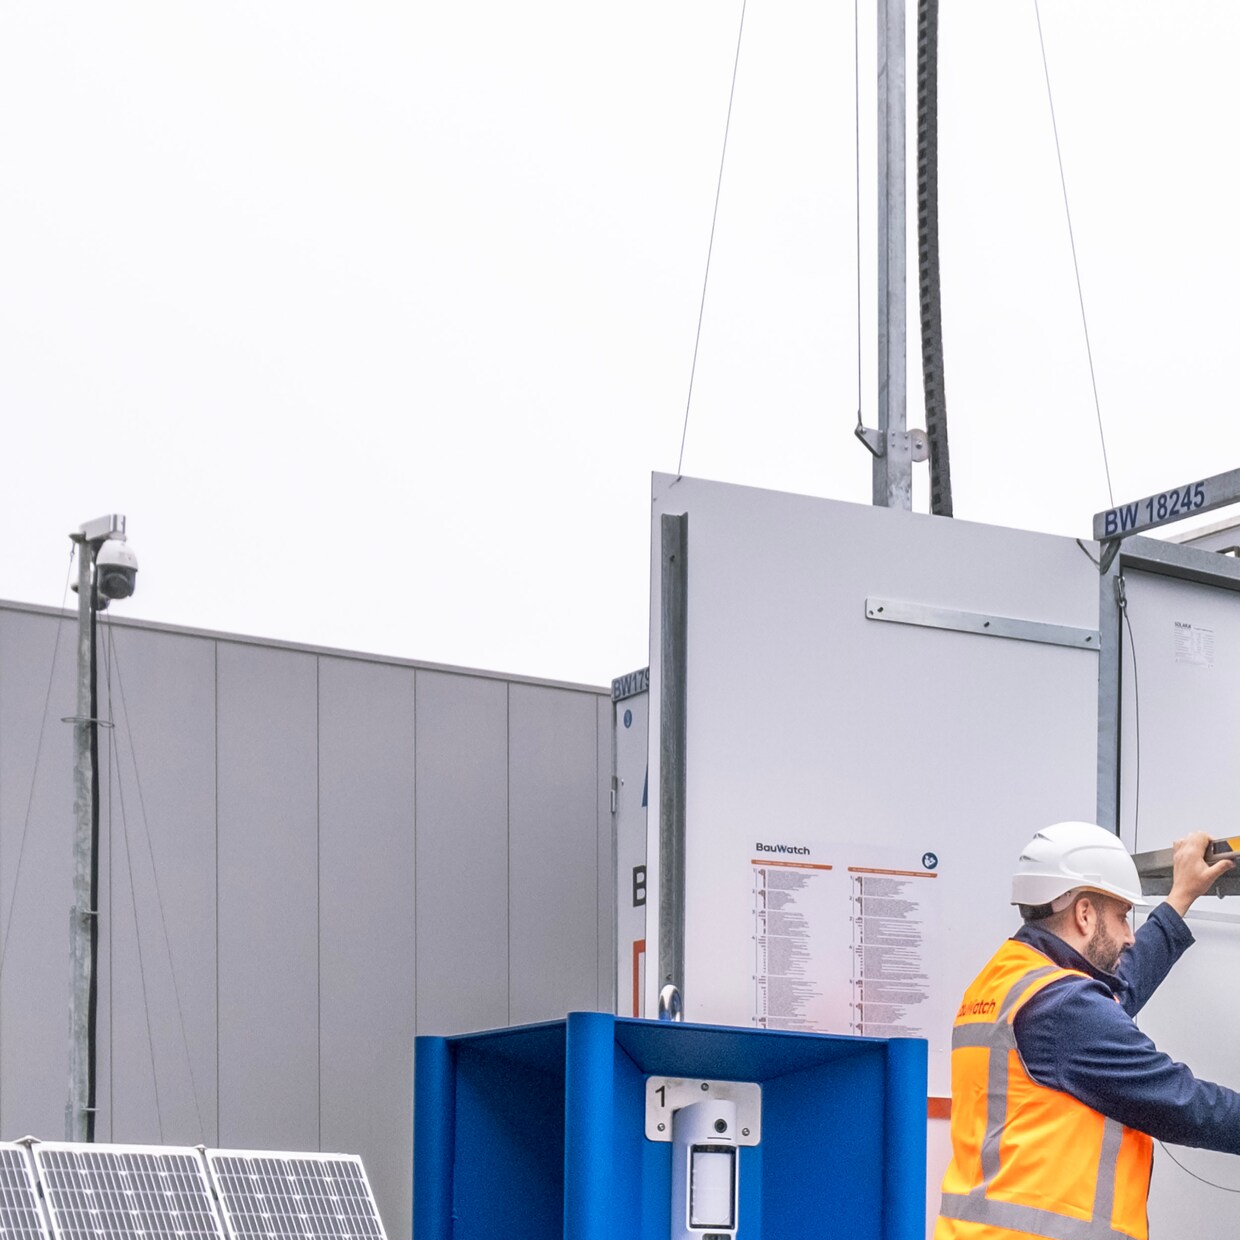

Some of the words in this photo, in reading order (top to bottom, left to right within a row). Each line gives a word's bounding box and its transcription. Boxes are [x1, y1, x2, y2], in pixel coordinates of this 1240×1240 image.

[1105, 502, 1139, 536] BW
[1146, 481, 1205, 522] 18245
[755, 842, 811, 856] BauWatch
[655, 1085, 665, 1107] 1
